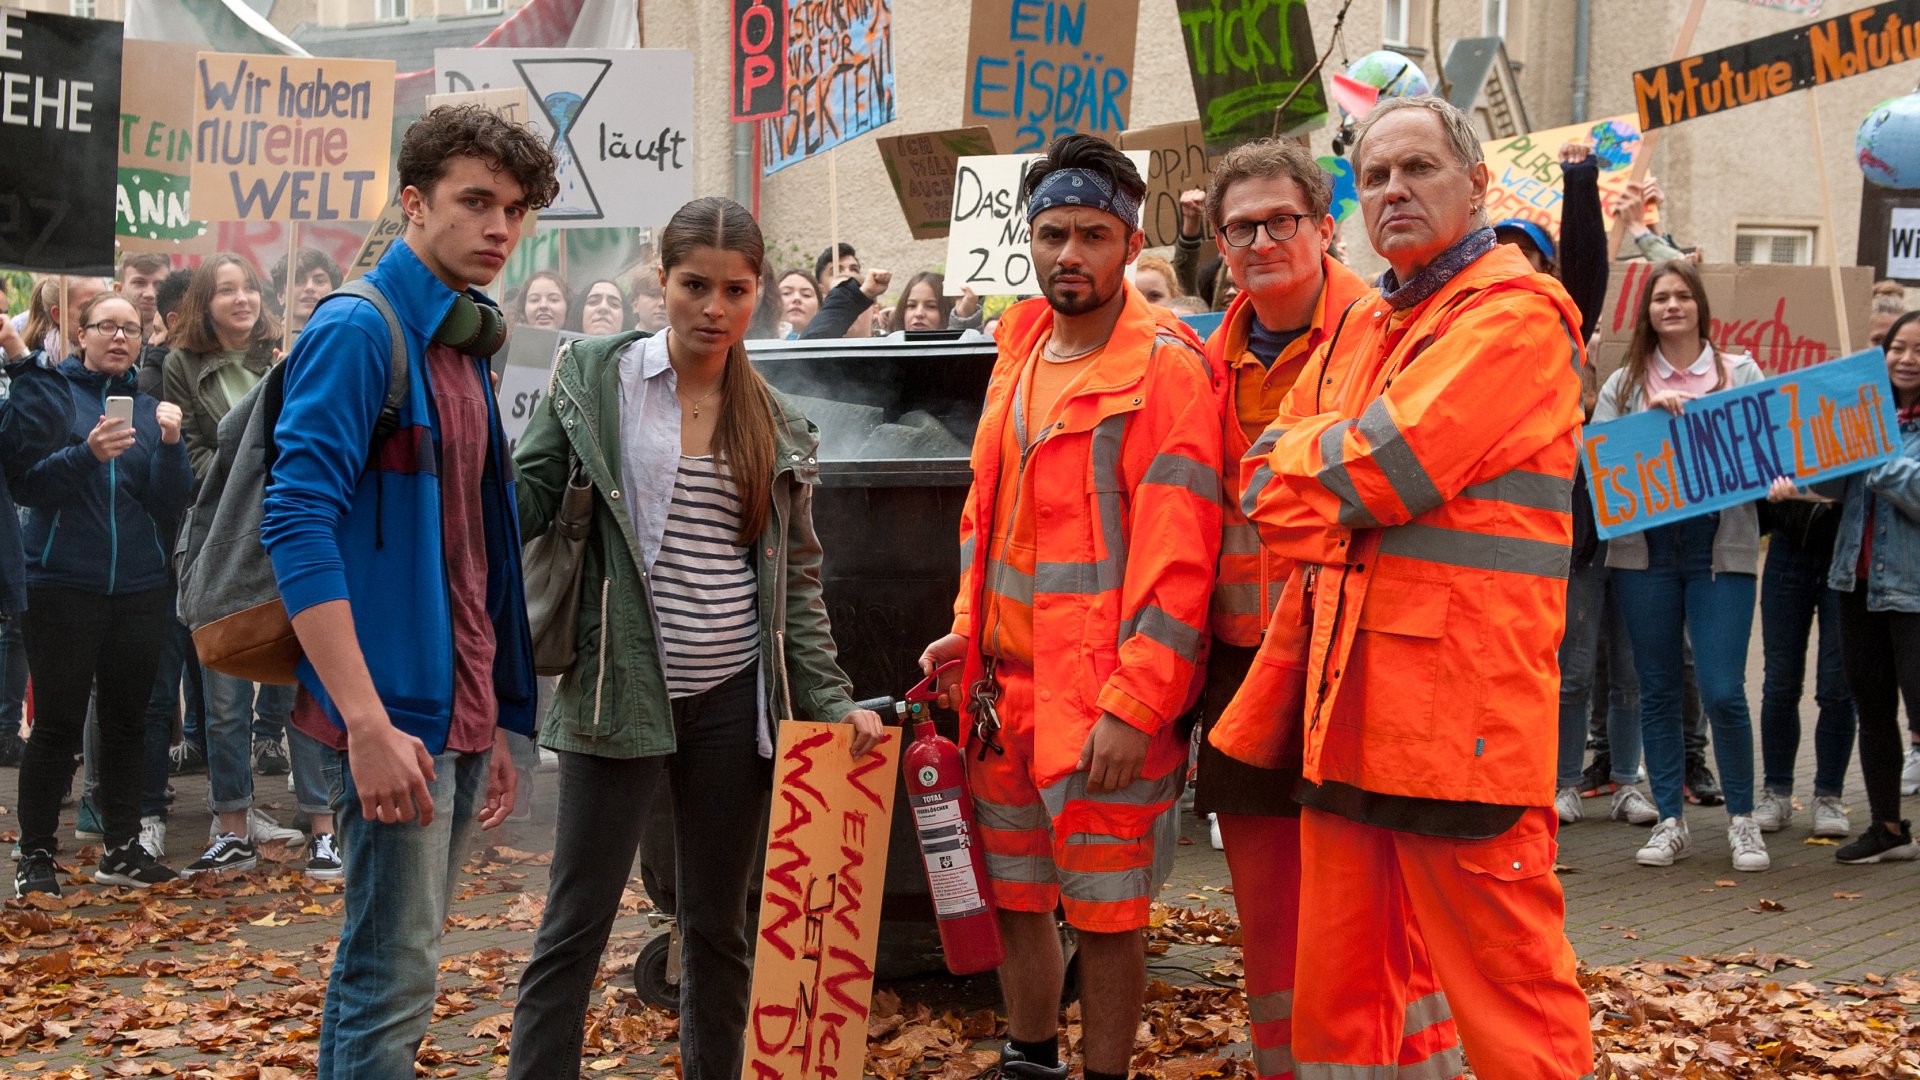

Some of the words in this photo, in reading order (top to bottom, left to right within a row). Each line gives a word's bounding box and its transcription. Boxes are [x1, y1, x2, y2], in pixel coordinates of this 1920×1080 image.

[1010, 0, 1086, 47] EIN
[199, 59, 272, 115] Wir
[278, 66, 371, 120] haben
[1680, 56, 1793, 119] Future
[1808, 20, 1858, 85] No
[0, 72, 94, 133] EHE
[197, 117, 268, 165] nur
[264, 119, 349, 167] eine
[600, 122, 686, 171] läuft
[229, 170, 376, 220] WELT
[1501, 167, 1564, 209] WELT
[1584, 434, 1638, 529] Es
[1634, 439, 1687, 517] ist
[1669, 389, 1796, 505] UNSERE
[1779, 383, 1895, 479] Zukunft
[922, 793, 943, 804] TOTAL
[760, 730, 834, 961] WANN
